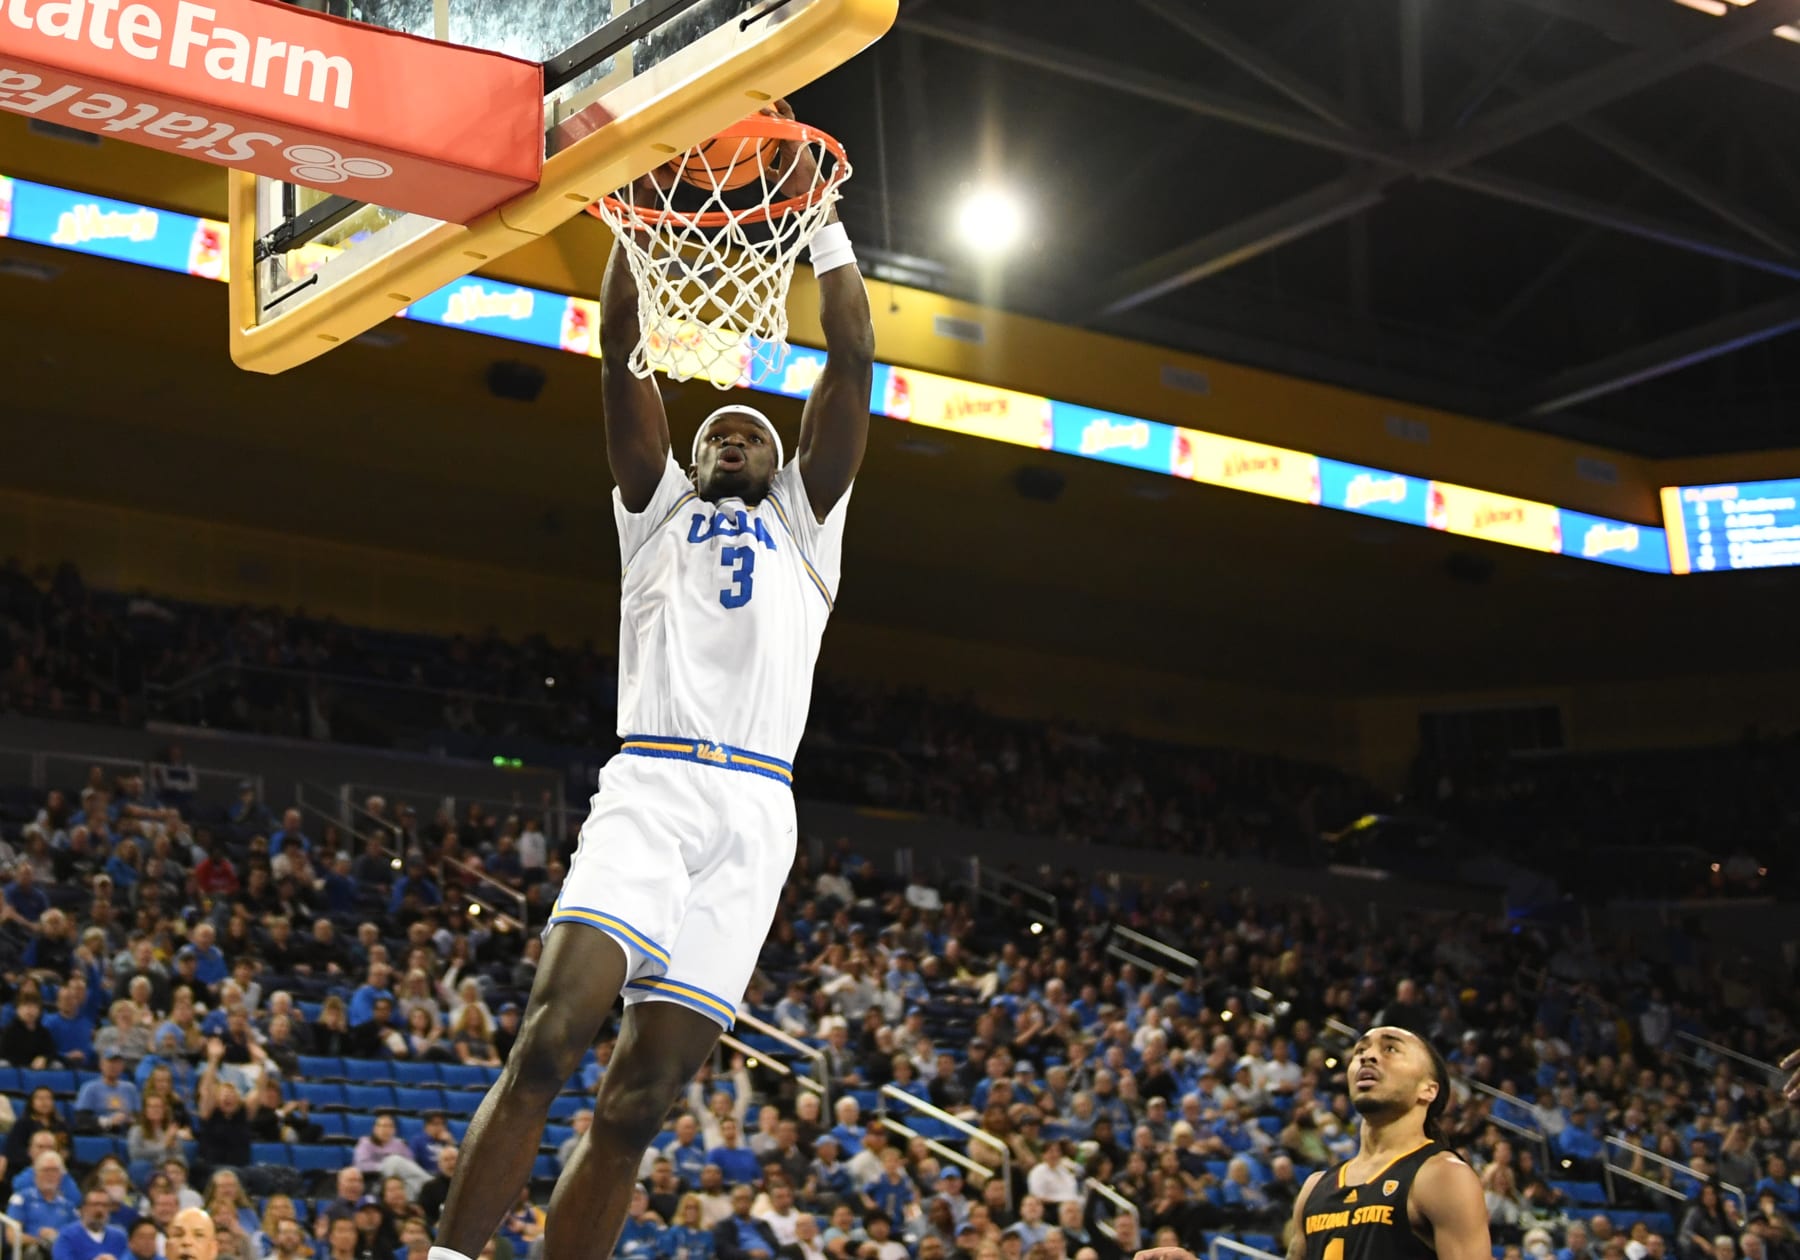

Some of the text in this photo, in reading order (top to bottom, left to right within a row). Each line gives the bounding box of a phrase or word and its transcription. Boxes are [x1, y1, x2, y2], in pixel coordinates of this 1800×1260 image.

[0, 0, 162, 60] tate
[720, 545, 755, 609] 3
[1352, 1204, 1395, 1225] STATE
